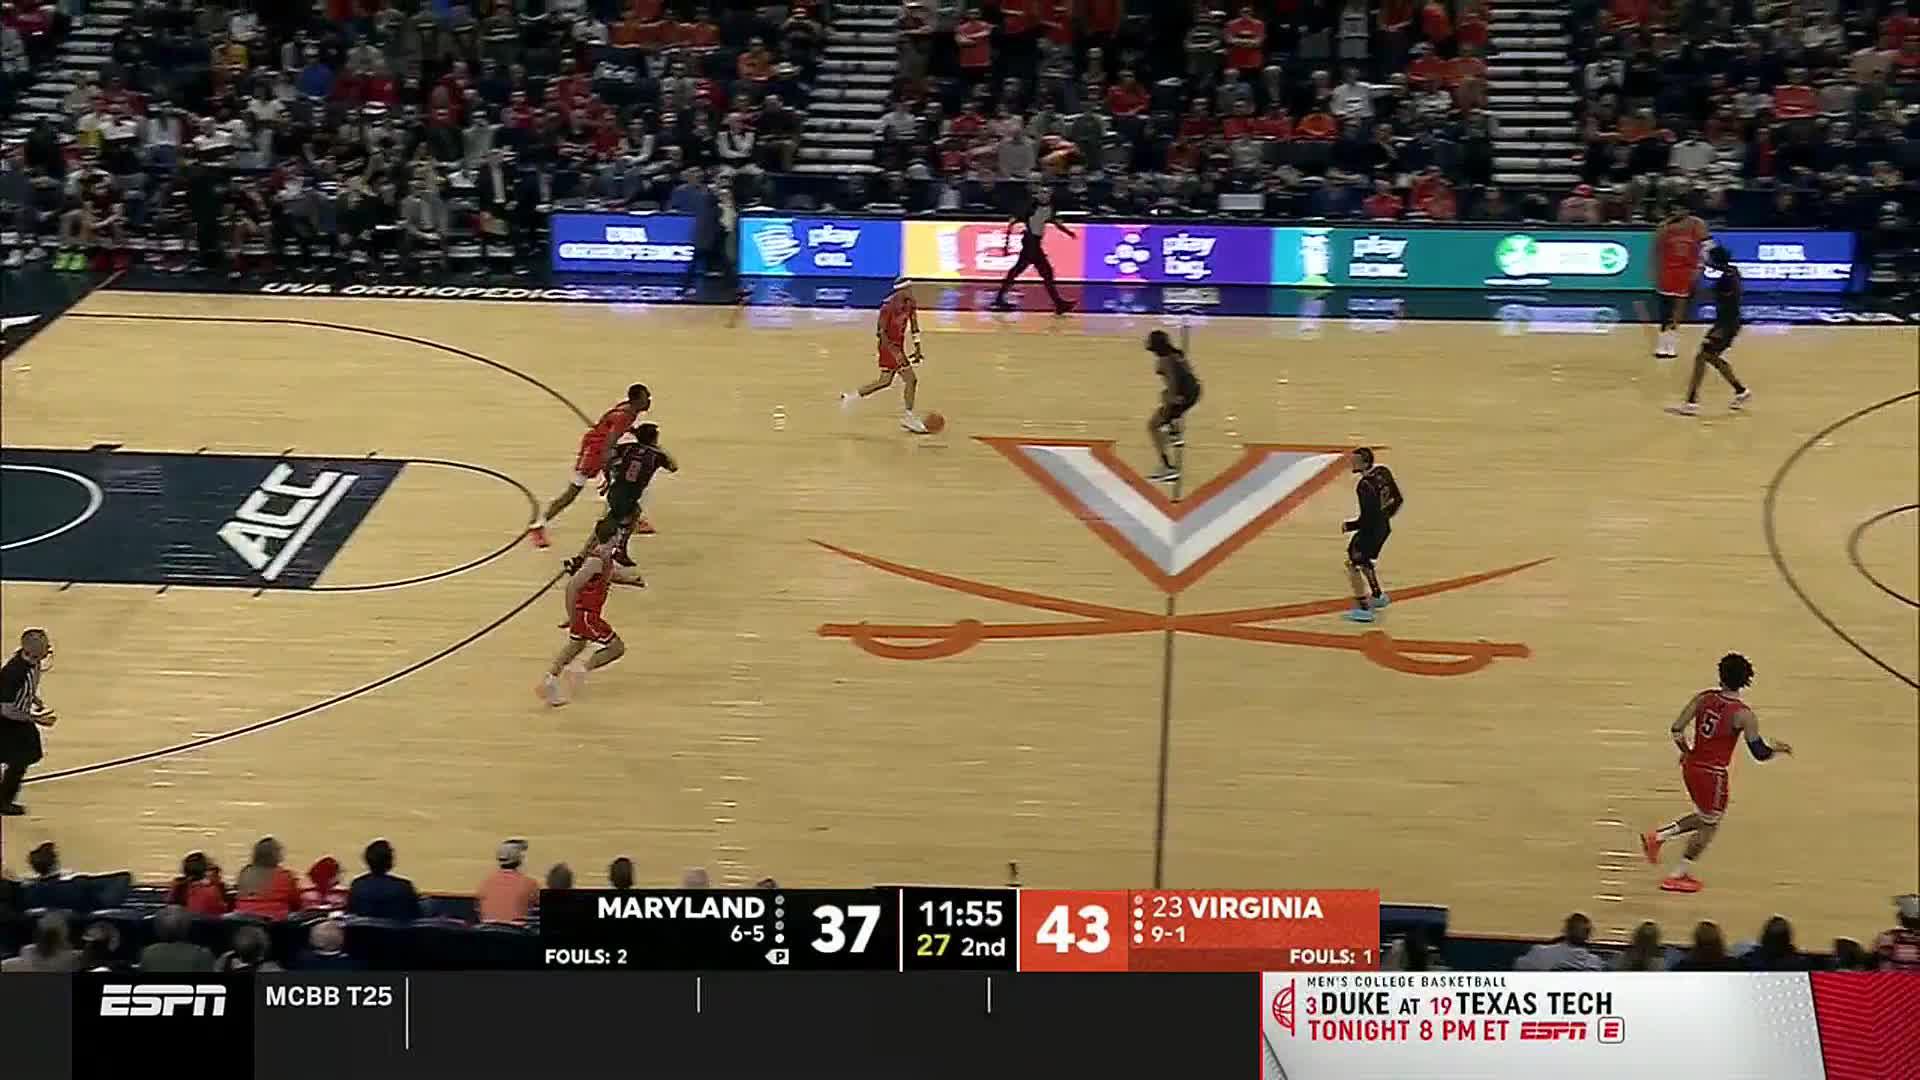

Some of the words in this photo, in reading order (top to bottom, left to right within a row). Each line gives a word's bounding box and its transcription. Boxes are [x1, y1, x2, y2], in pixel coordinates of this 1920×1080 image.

[1162, 233, 1216, 256] play
[1353, 235, 1408, 258] play
[216, 462, 345, 570] ACC
[1702, 710, 1721, 738] 5
